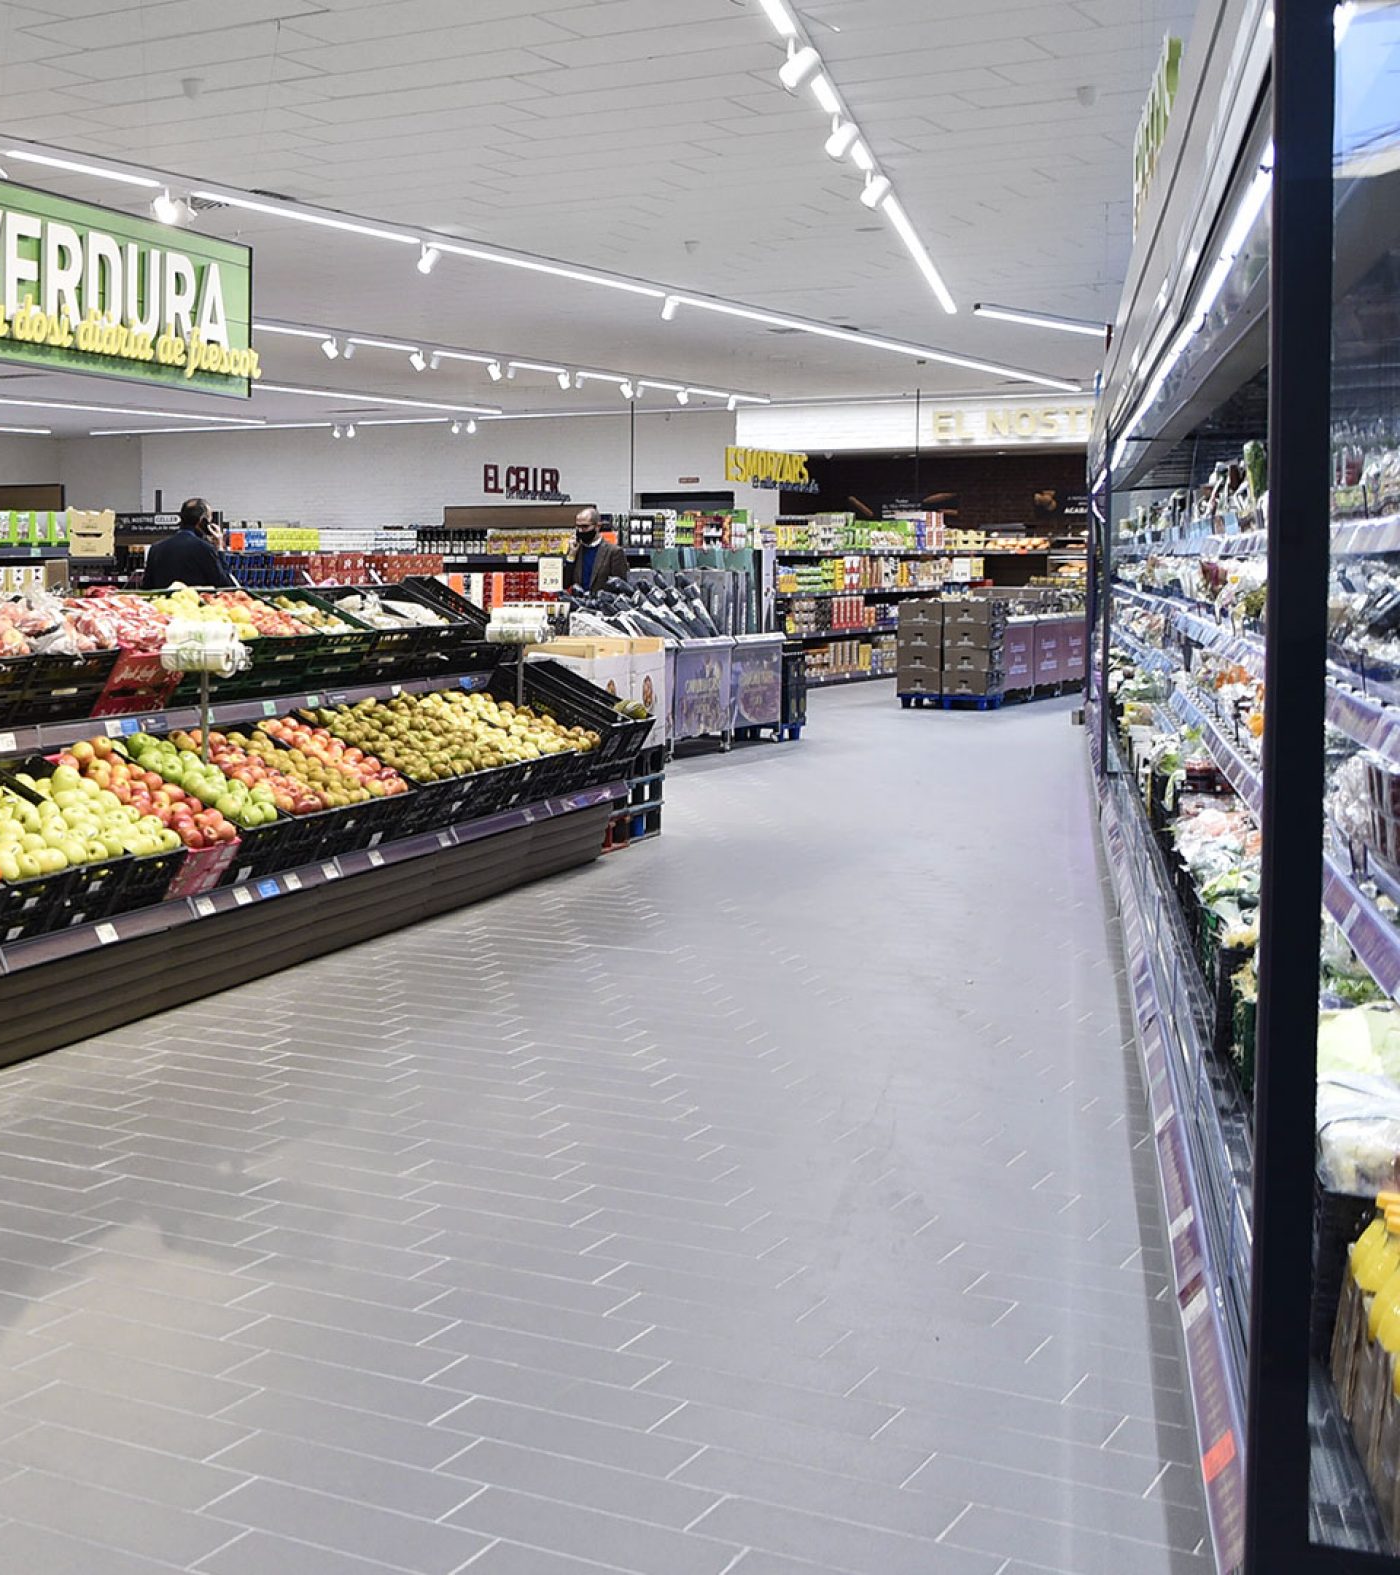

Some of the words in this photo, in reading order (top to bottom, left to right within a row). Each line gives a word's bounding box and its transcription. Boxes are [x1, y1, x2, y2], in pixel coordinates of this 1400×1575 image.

[13, 294, 73, 347] dosi
[77, 308, 154, 361] diària
[156, 322, 186, 366] de
[186, 326, 261, 379] frescor
[932, 410, 973, 440] EL
[724, 446, 809, 485] ESMORZARS
